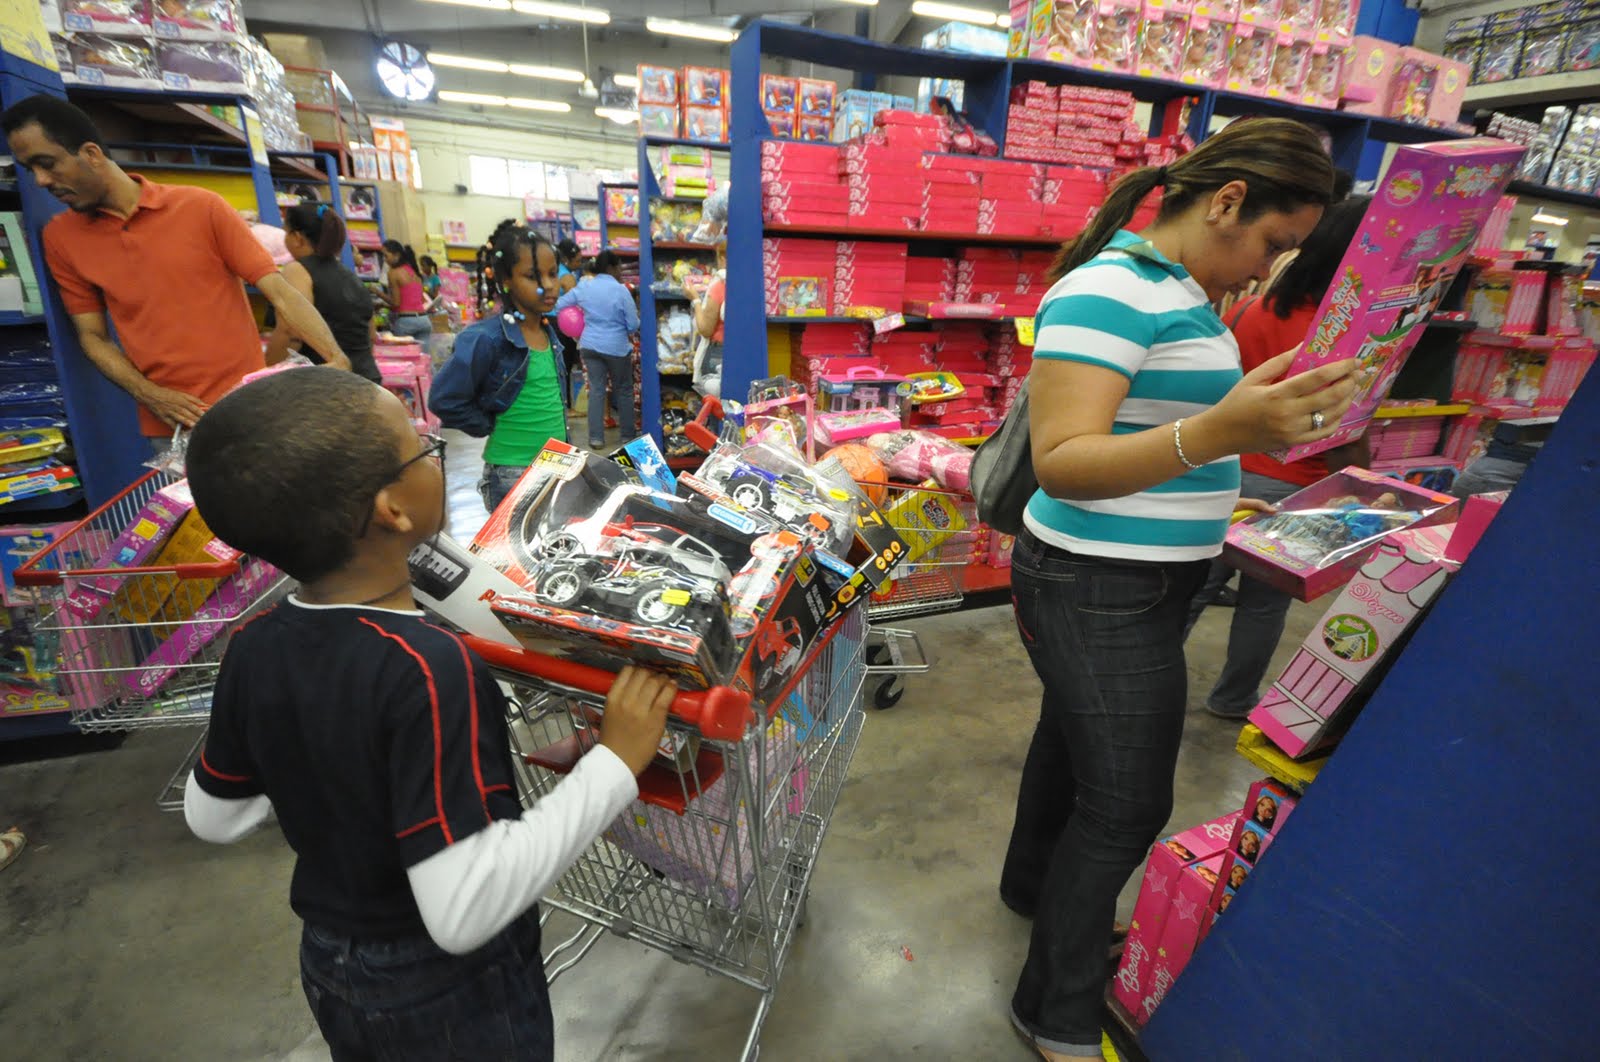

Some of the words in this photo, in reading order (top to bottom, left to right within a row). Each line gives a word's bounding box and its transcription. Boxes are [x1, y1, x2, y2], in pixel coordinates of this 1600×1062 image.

[1312, 288, 1361, 358] Happy
[1348, 581, 1405, 625] Vogue
[1118, 937, 1149, 993] Beauty
